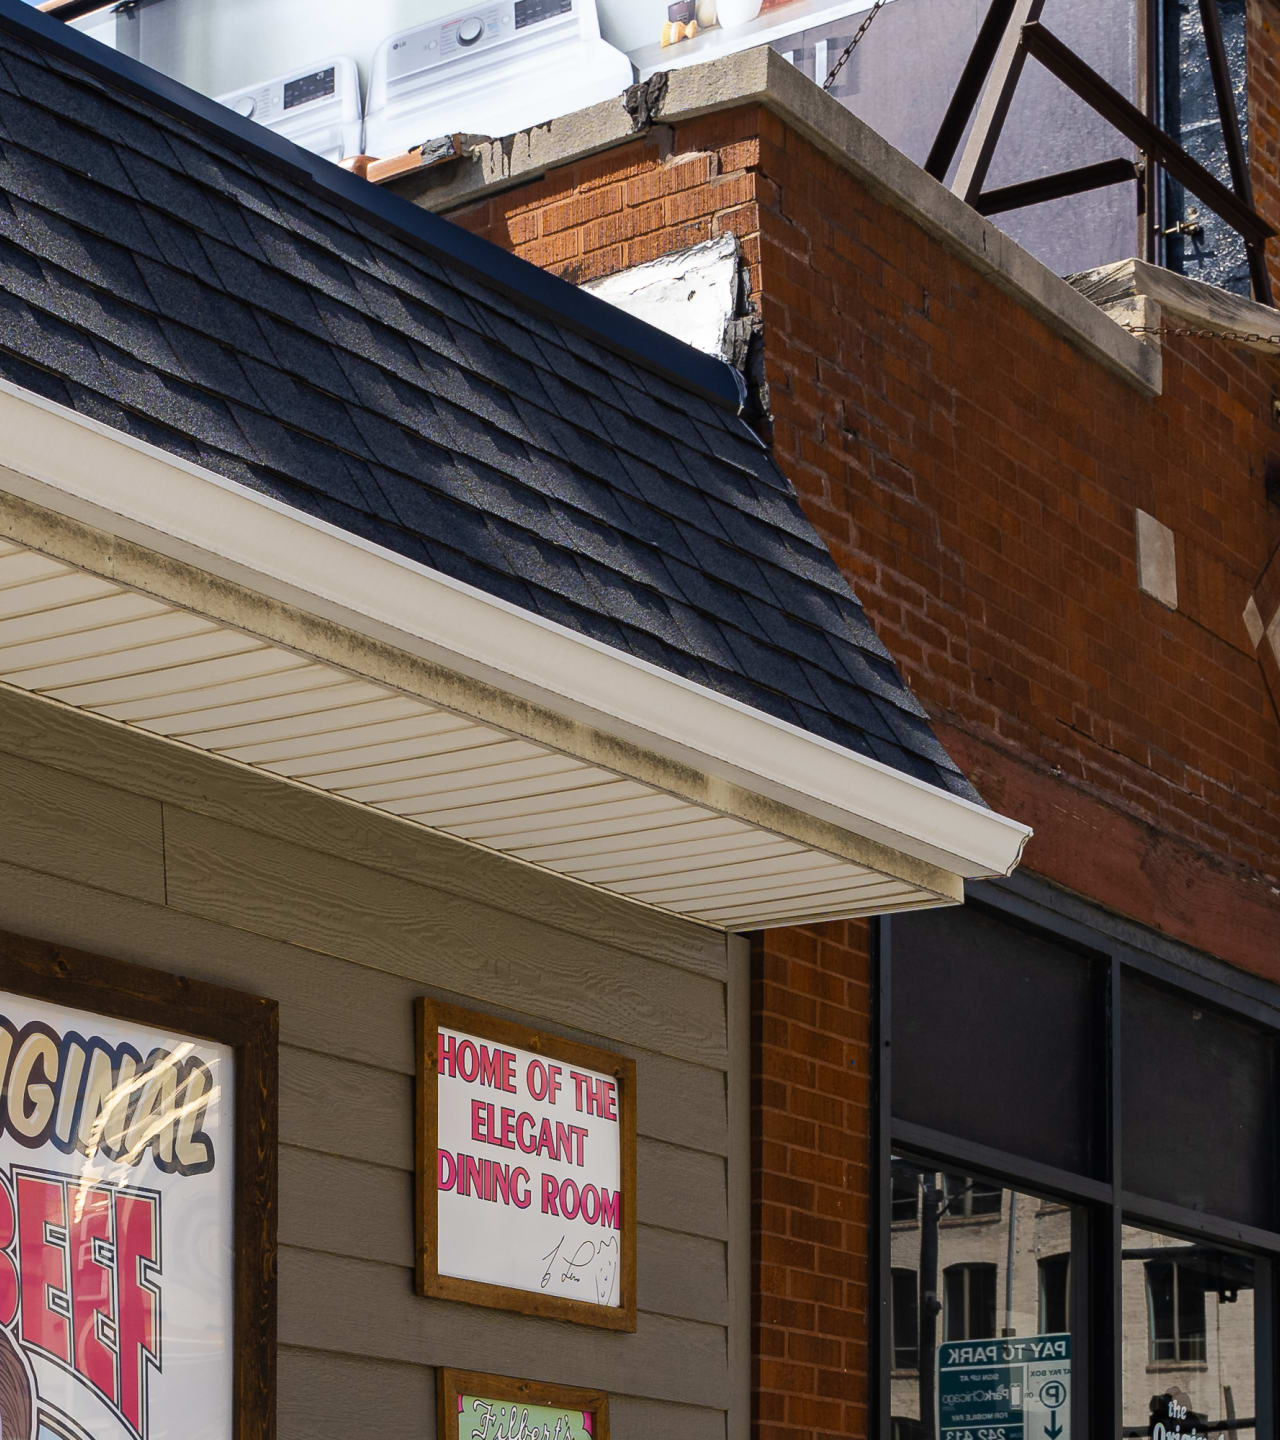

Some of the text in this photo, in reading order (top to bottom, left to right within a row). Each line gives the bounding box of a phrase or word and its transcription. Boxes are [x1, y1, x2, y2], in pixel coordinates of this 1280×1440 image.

[437, 1033, 617, 1122] HOME OF THE
[470, 1098, 588, 1167] ELEGANT
[437, 1149, 621, 1231] DINING ROOM
[1168, 1399, 1187, 1420] the
